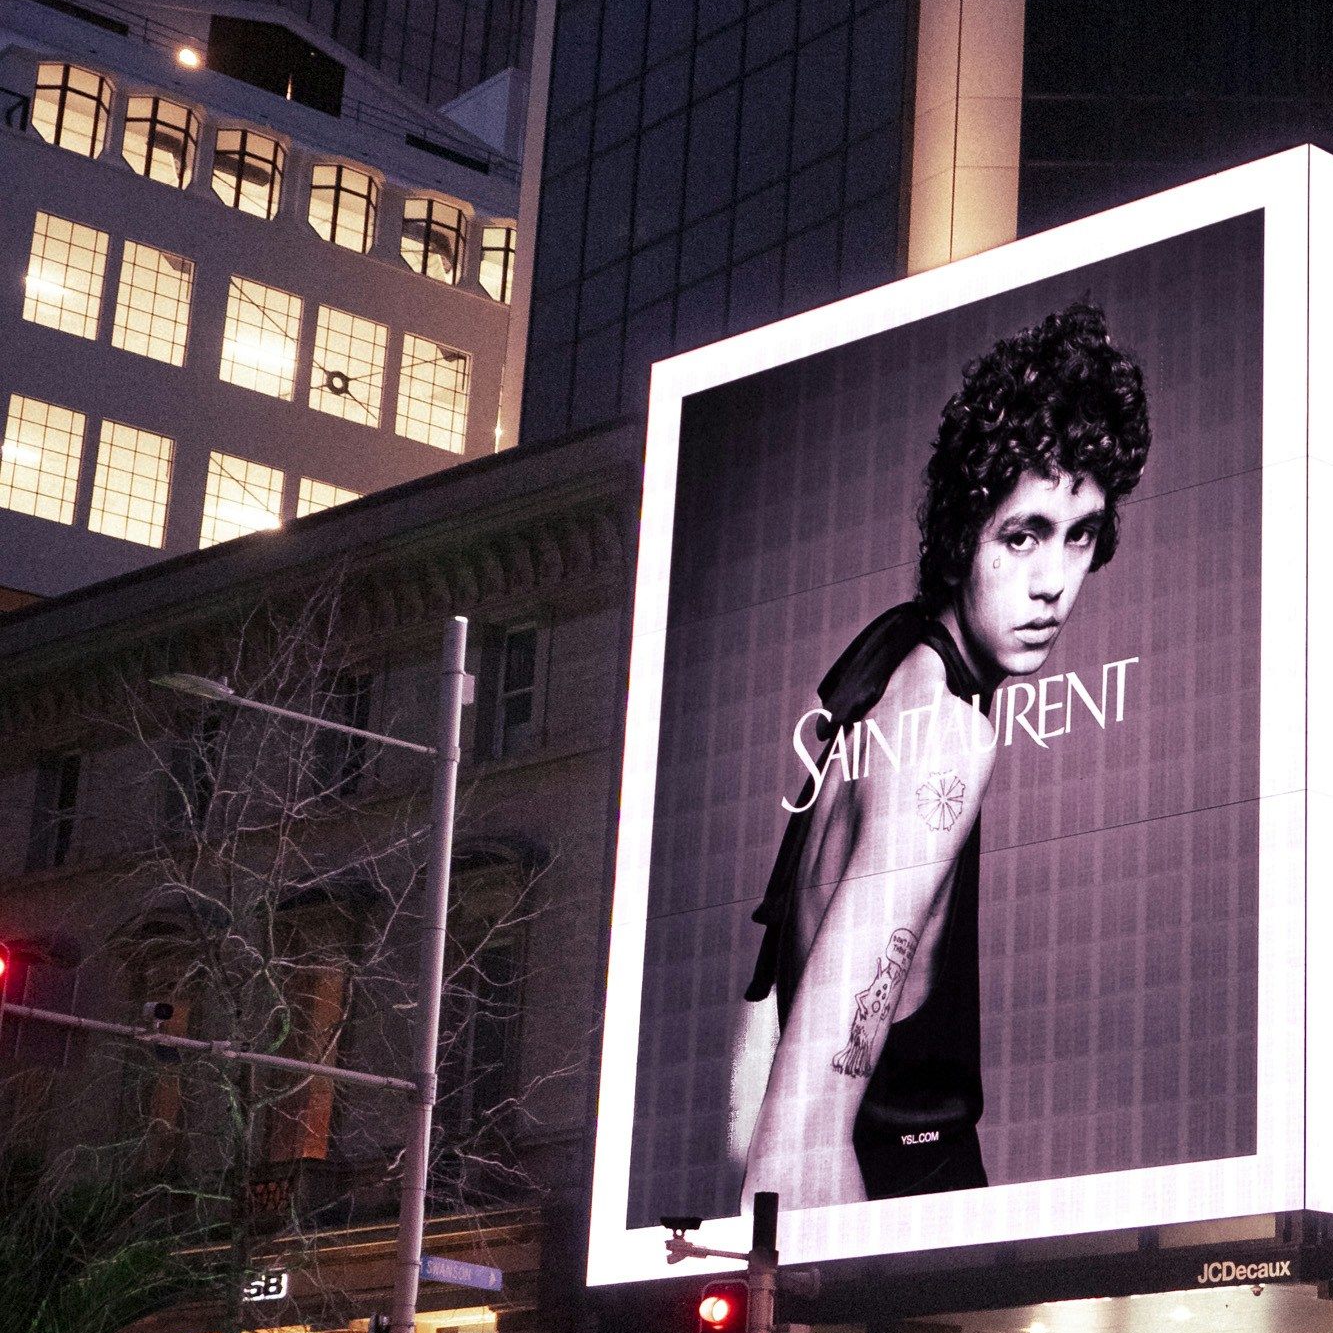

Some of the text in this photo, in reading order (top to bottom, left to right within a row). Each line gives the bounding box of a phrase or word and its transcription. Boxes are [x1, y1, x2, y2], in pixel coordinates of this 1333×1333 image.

[900, 1130, 940, 1146] YSL.COM
[425, 1259, 472, 1281] SWANSON
[1197, 1260, 1291, 1284] JCDecaux
[243, 1269, 288, 1302] SB
